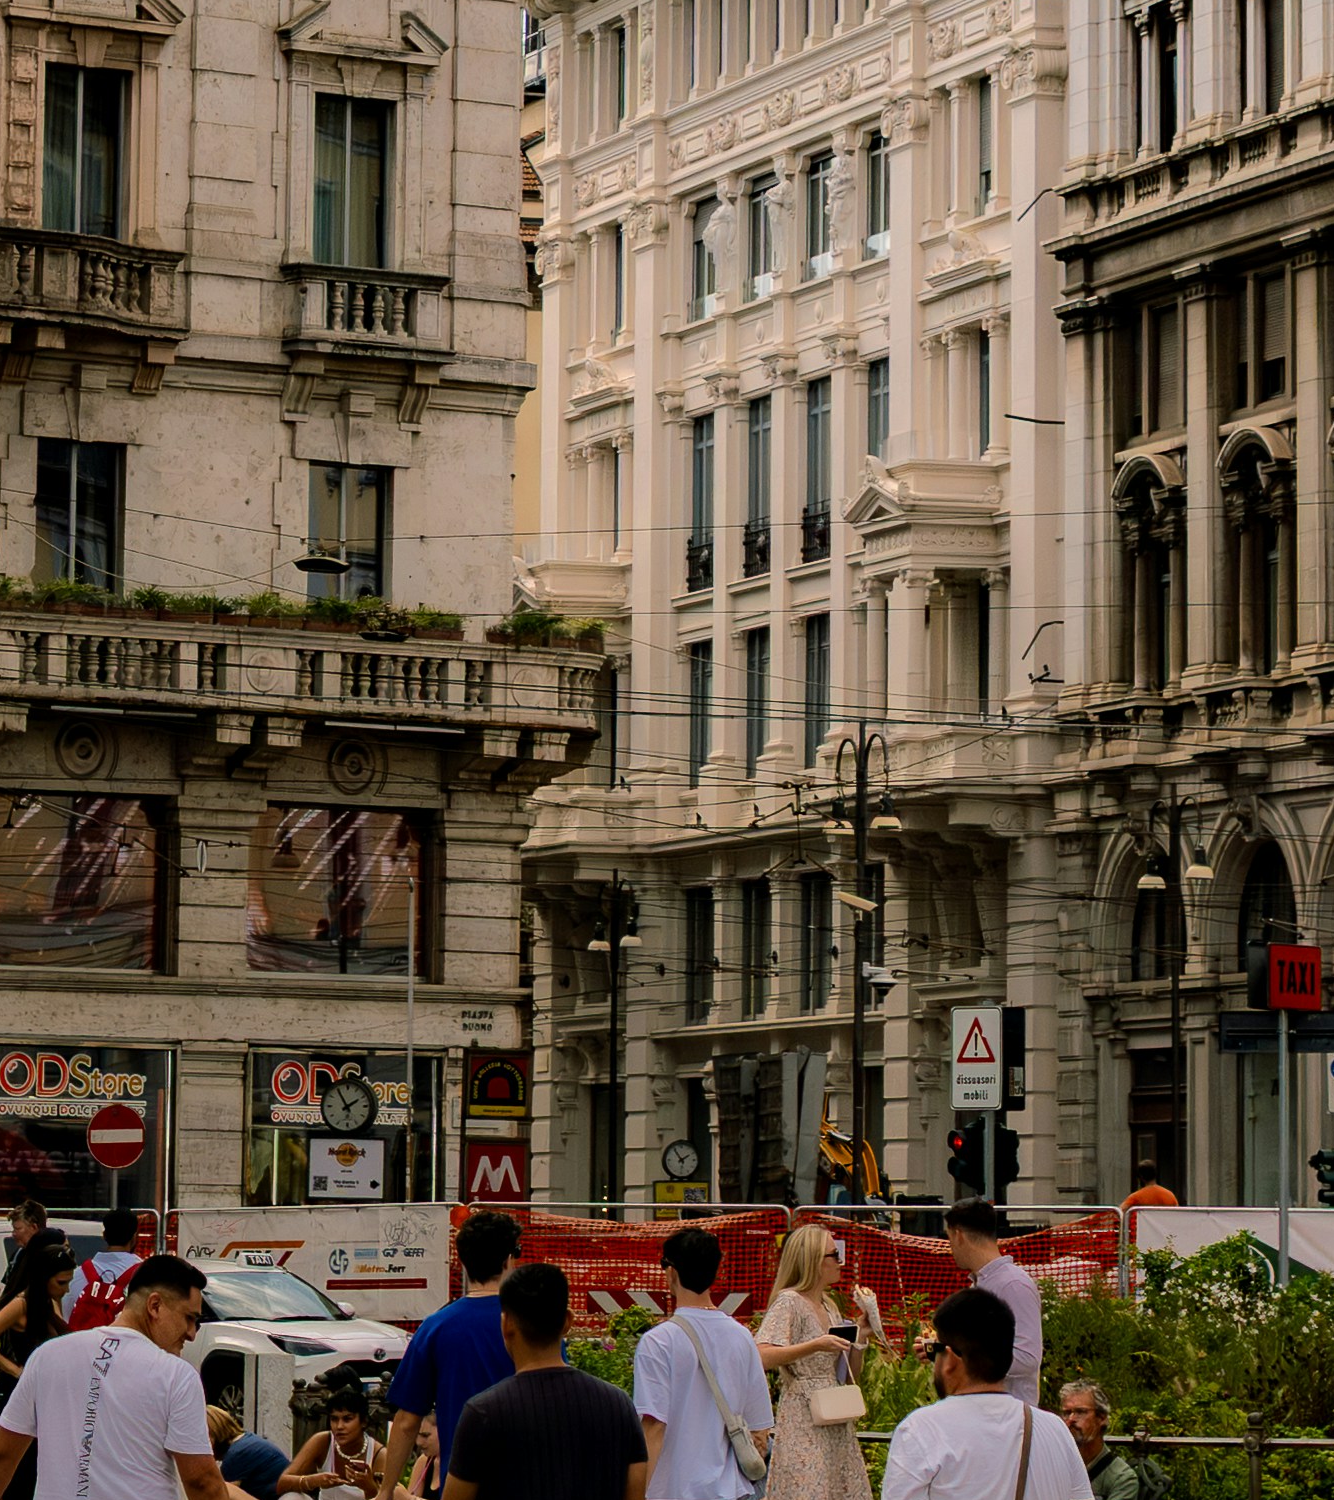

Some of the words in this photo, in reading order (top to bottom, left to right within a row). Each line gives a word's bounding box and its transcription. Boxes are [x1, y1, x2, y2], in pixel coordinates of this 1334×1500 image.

[1278, 960, 1316, 996] TAXI
[956, 1074, 997, 1085] dissuasori
[963, 1090, 989, 1101] mobili
[471, 1155, 521, 1193] M
[248, 1254, 272, 1266] TAXI
[77, 1450, 91, 1498] ARMANI
